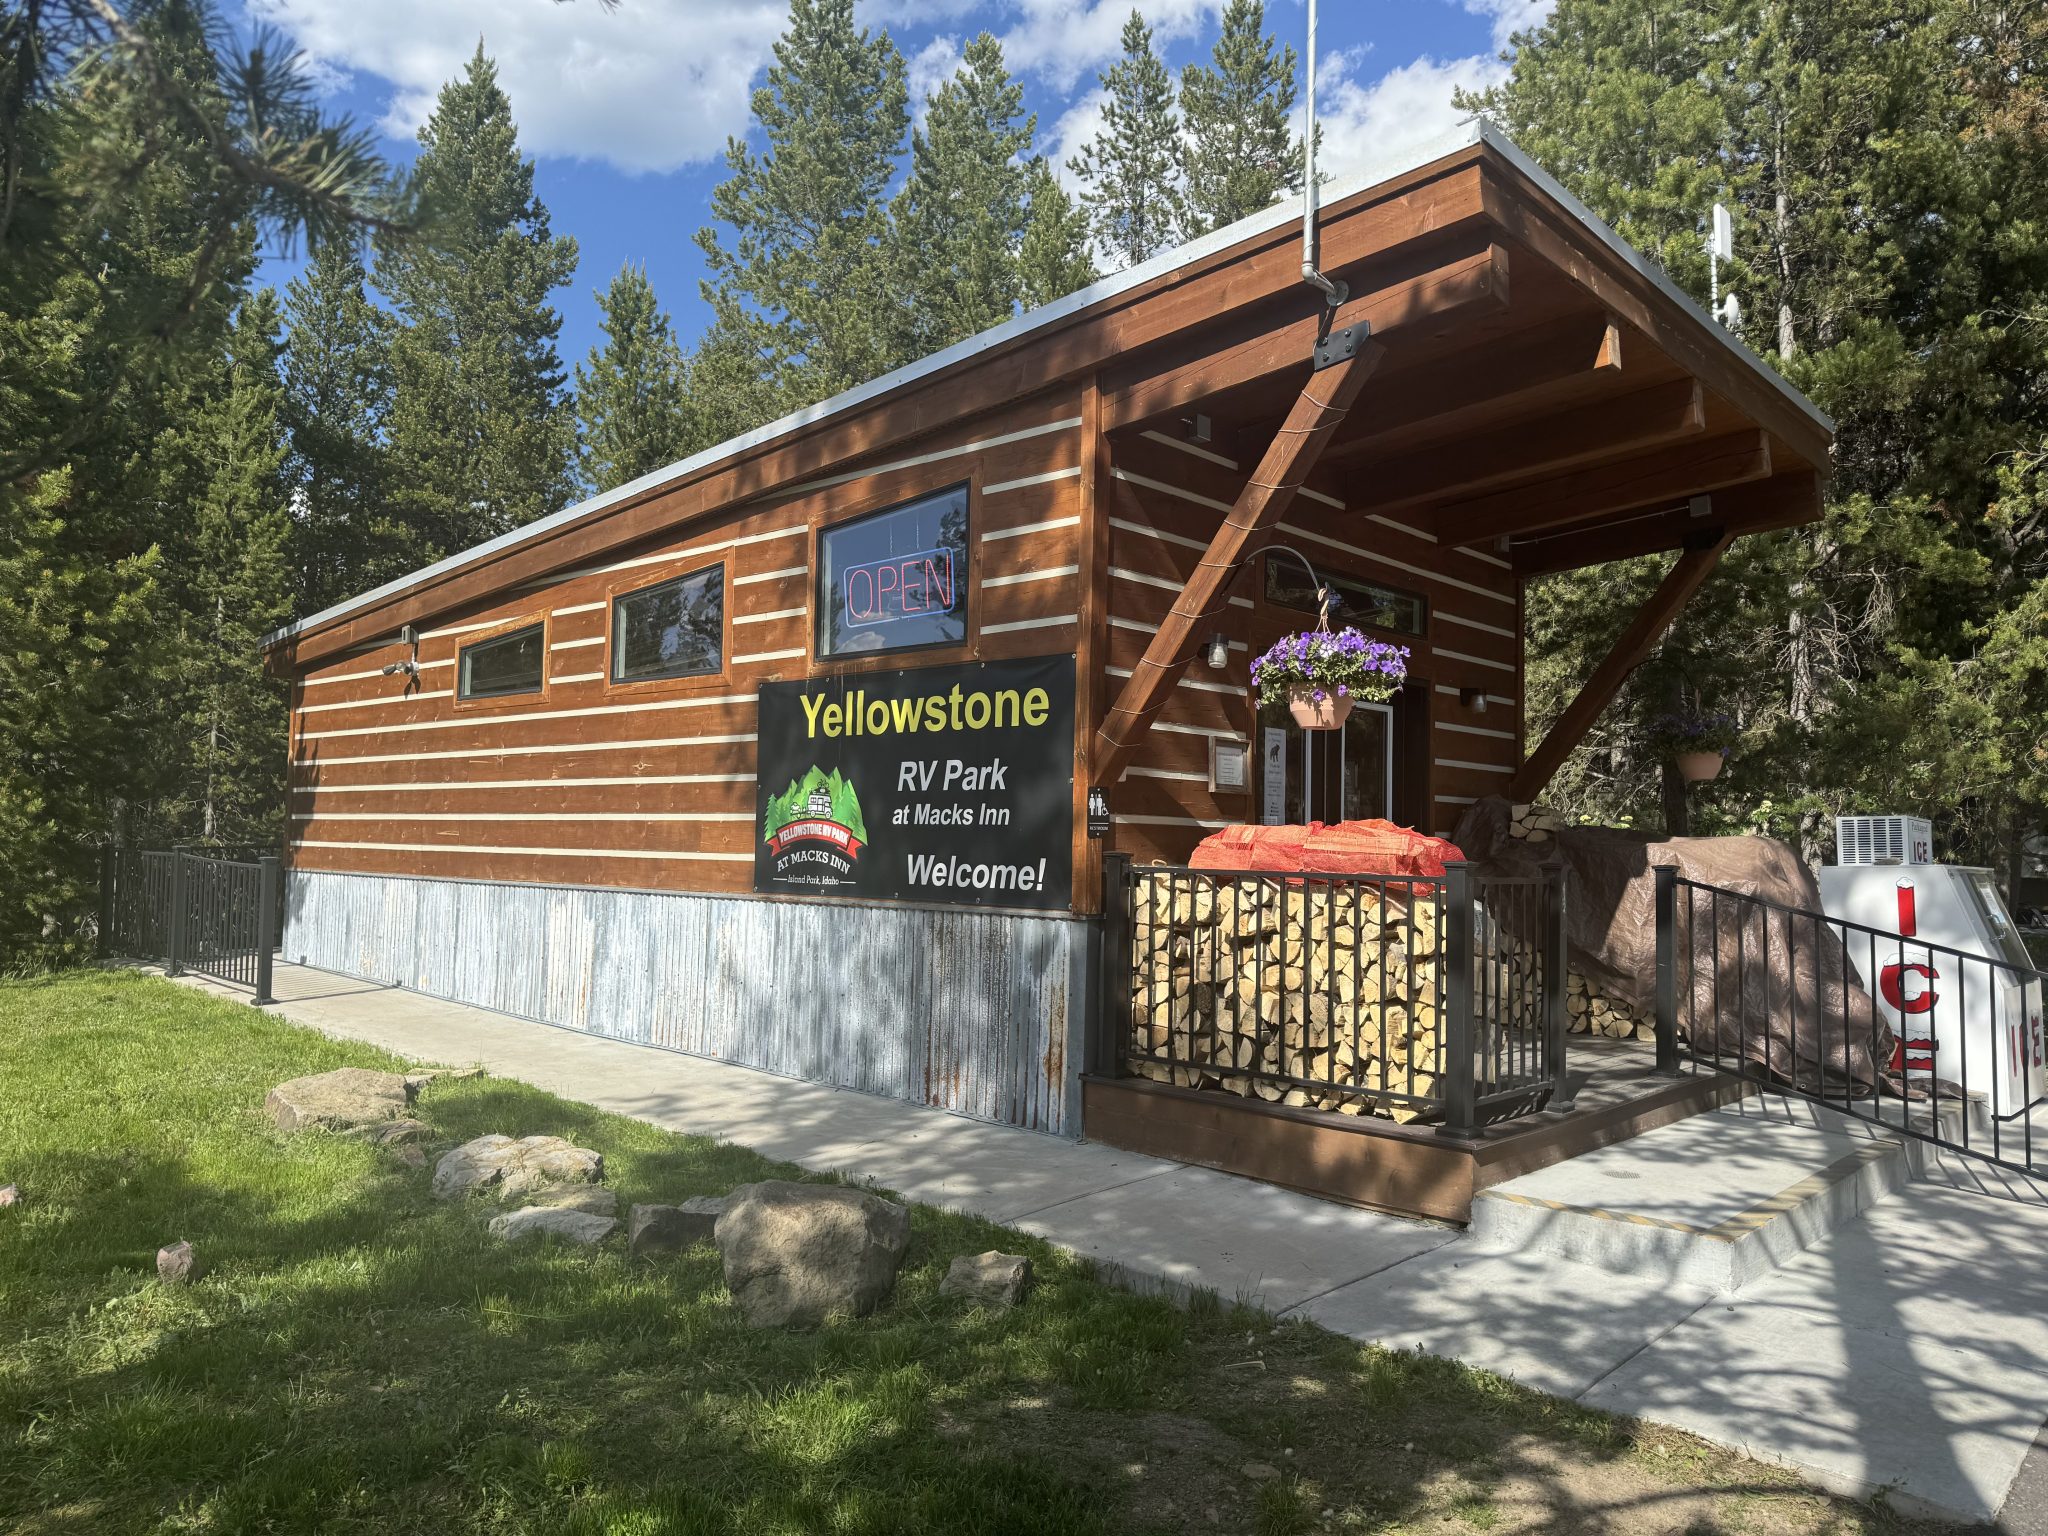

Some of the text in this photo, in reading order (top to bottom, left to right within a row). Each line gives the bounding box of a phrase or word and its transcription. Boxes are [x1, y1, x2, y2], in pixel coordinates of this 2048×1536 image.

[849, 554, 951, 619] OPEN
[800, 683, 1049, 738] Yellowstone
[898, 758, 1008, 791] RV Park
[892, 803, 1010, 826] at Macks Inn
[779, 823, 849, 846] YELLOWSTONE RV PARK
[777, 850, 851, 874] AT MACKS INN
[1913, 840, 1928, 863] ICE
[787, 874, 839, 885] Island Park, Idaho
[907, 854, 1046, 891] Welcome!
